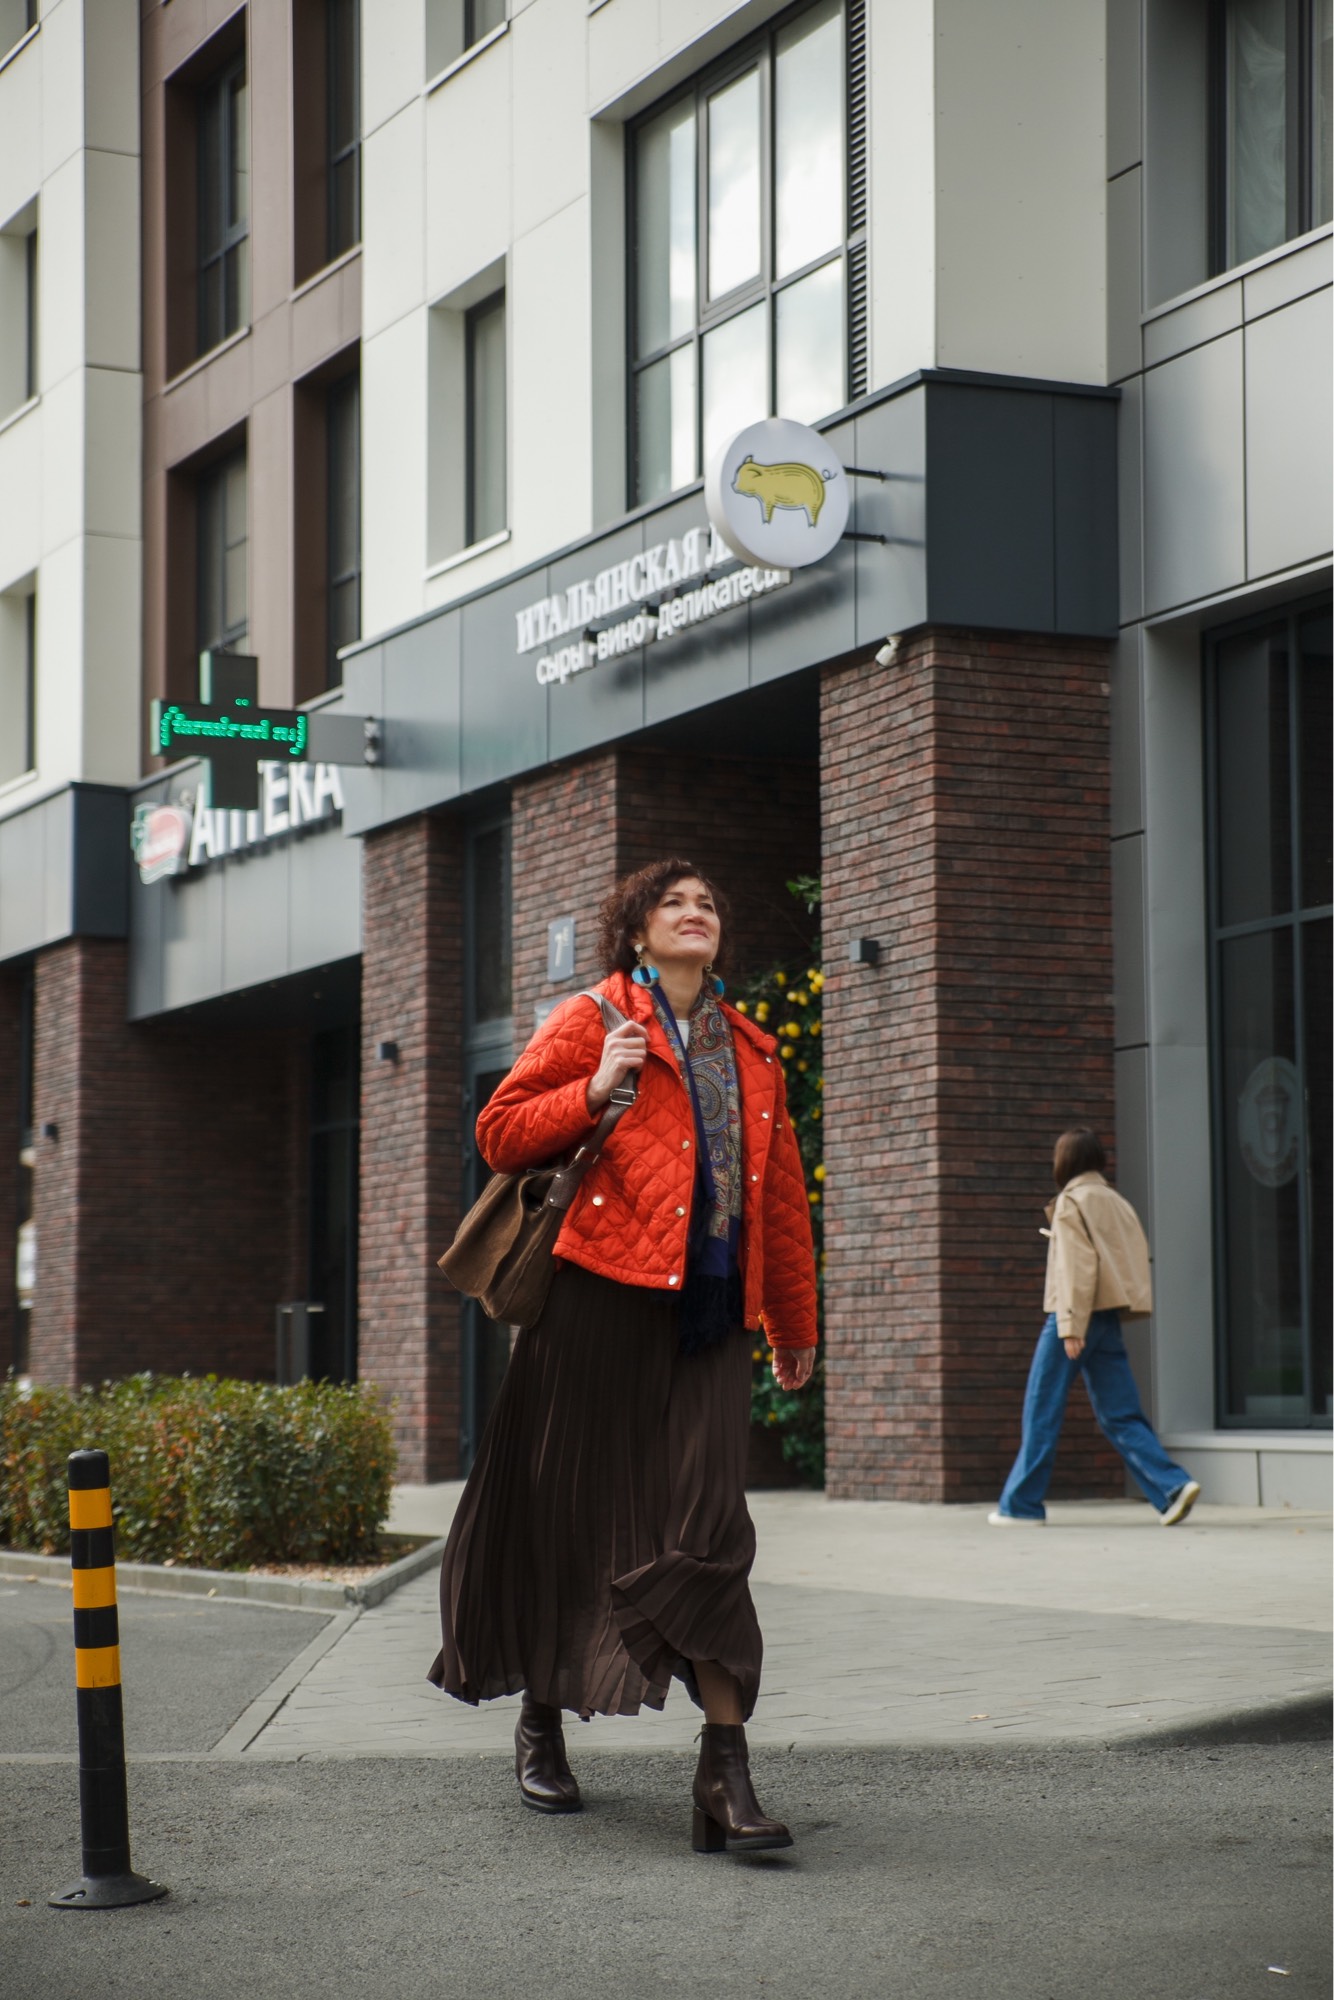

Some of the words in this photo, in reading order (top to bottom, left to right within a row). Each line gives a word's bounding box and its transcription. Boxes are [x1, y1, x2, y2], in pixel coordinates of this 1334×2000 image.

[515, 526, 700, 655] ИТАЛЬЯНСКАЯ
[536, 640, 588, 685] сыры
[597, 614, 646, 661] вино
[657, 566, 783, 641] деликатесы
